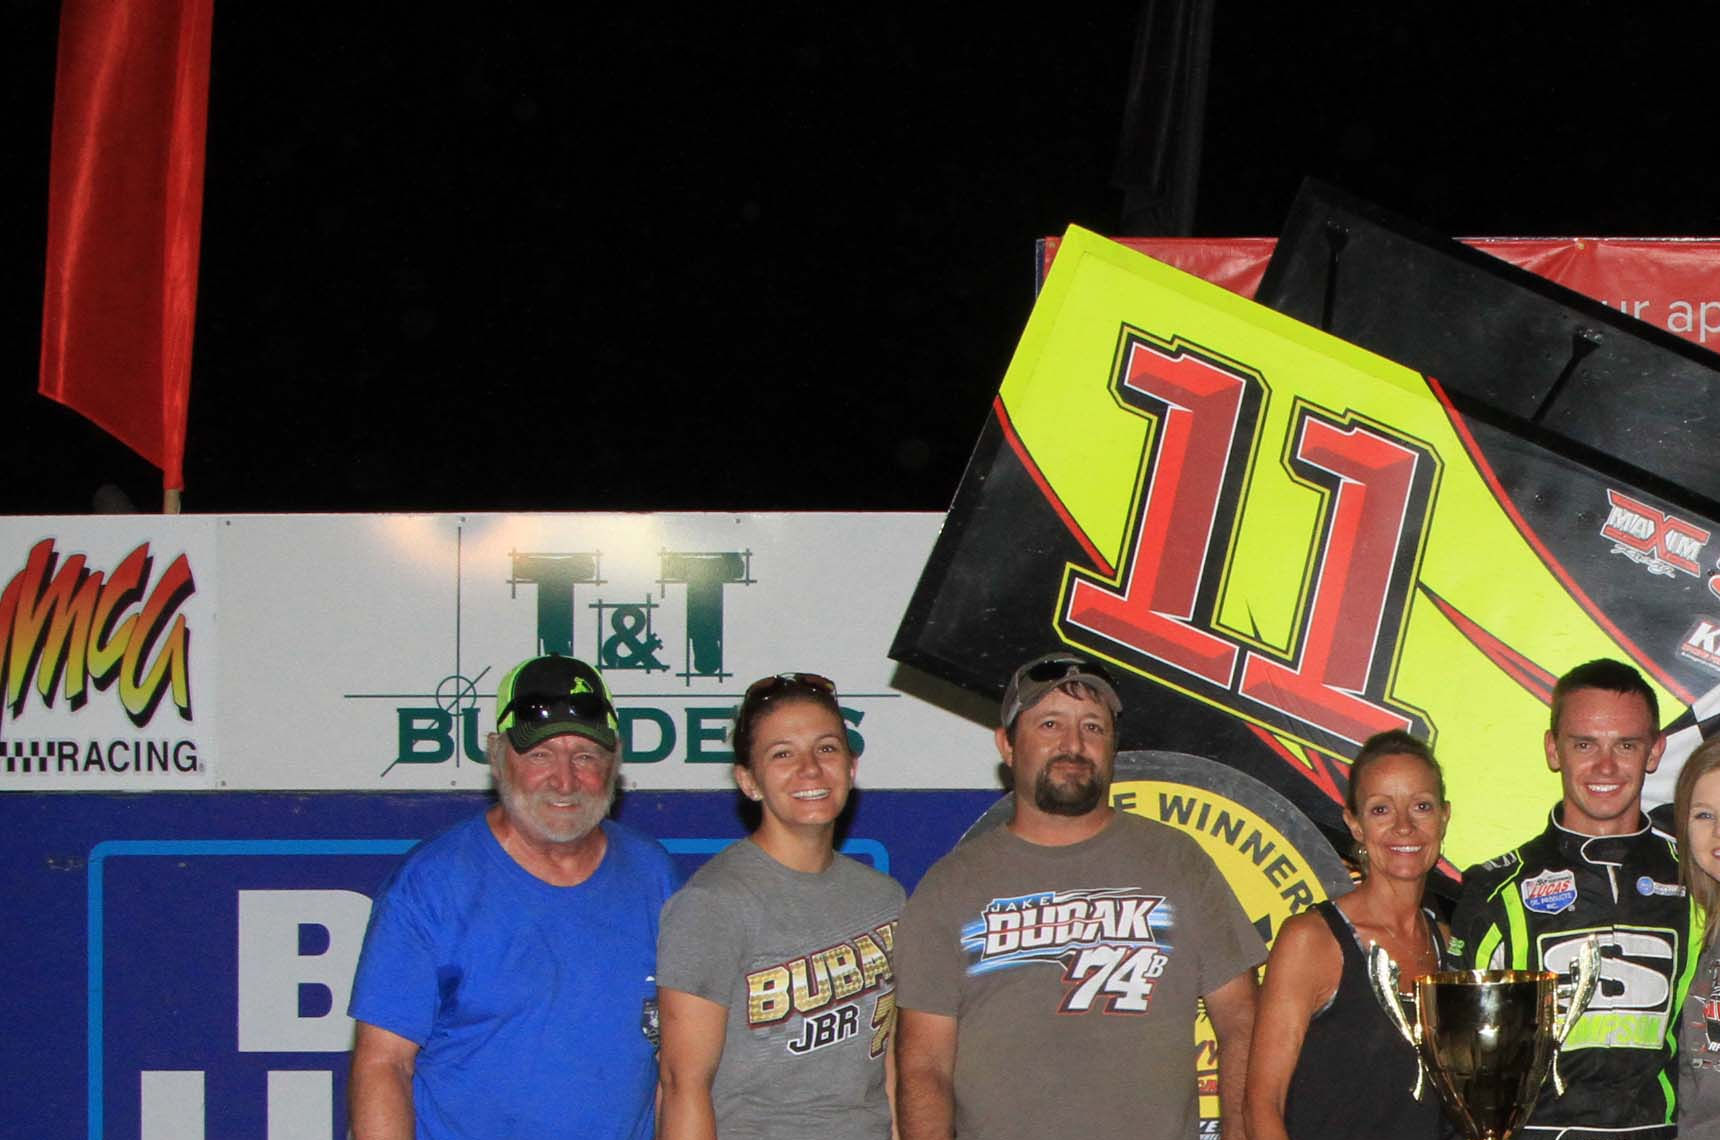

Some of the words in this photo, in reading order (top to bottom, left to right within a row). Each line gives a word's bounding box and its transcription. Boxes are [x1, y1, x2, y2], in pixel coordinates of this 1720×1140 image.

[1058, 328, 1430, 753] 11
[1601, 489, 1710, 578] MAXIM
[508, 550, 756, 686] T&T
[57, 740, 198, 773] RACING
[1158, 792, 1316, 915] WINNER
[991, 895, 1051, 913] JAKE
[1528, 879, 1571, 898] LUCAS
[986, 899, 1156, 955] BUBAK
[787, 1003, 860, 1055] JBR
